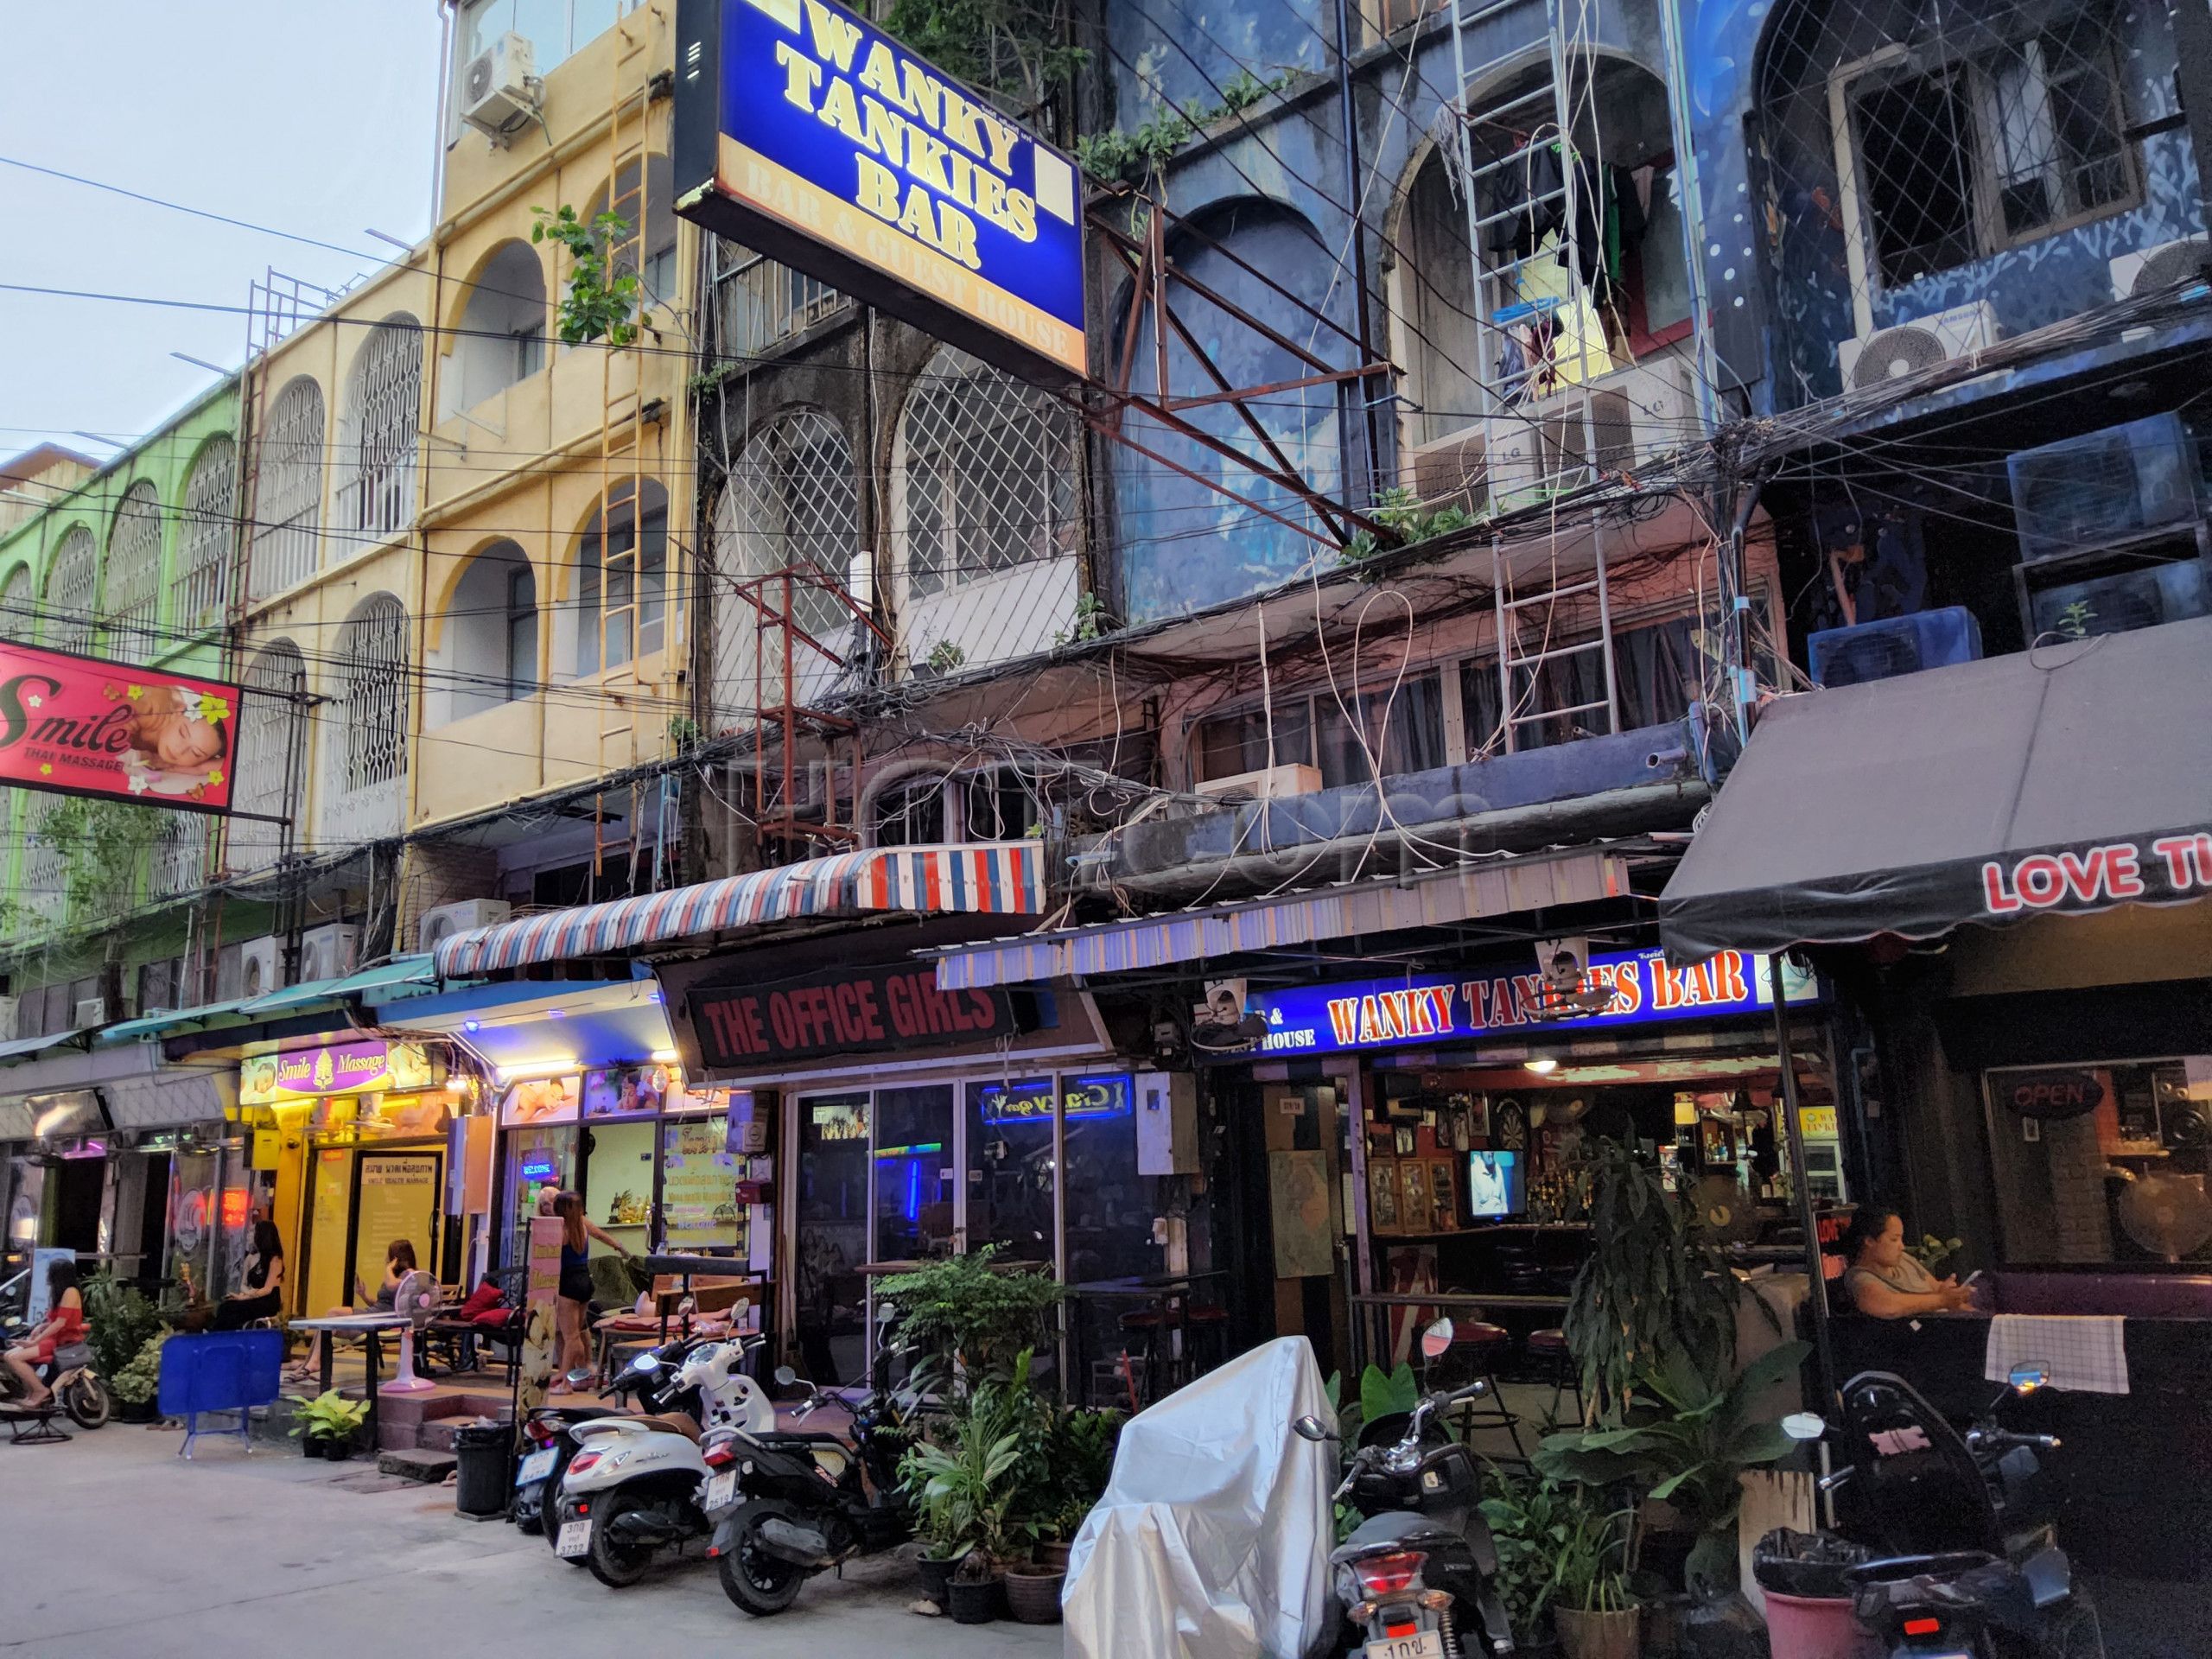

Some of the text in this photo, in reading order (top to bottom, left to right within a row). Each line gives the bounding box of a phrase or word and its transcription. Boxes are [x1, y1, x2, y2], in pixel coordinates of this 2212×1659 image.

[804, 0, 1020, 176] WANKY
[775, 39, 1038, 244] TANKIES
[854, 152, 982, 270] BAR
[746, 160, 1071, 359] BAR & GUEST HOUSE
[0, 675, 136, 753] Smile
[23, 746, 124, 774] THAI MASSAGE
[1981, 842, 2145, 913] LOVE
[703, 971, 995, 1058] THE OFFICE GIRLS
[1327, 983, 1455, 1046] WANKY
[1649, 950, 1749, 1010] BAR
[278, 1053, 385, 1082] Smile Massage
[1262, 1028, 1316, 1051] HOUSE
[2014, 1084, 2084, 1106] OPEN
